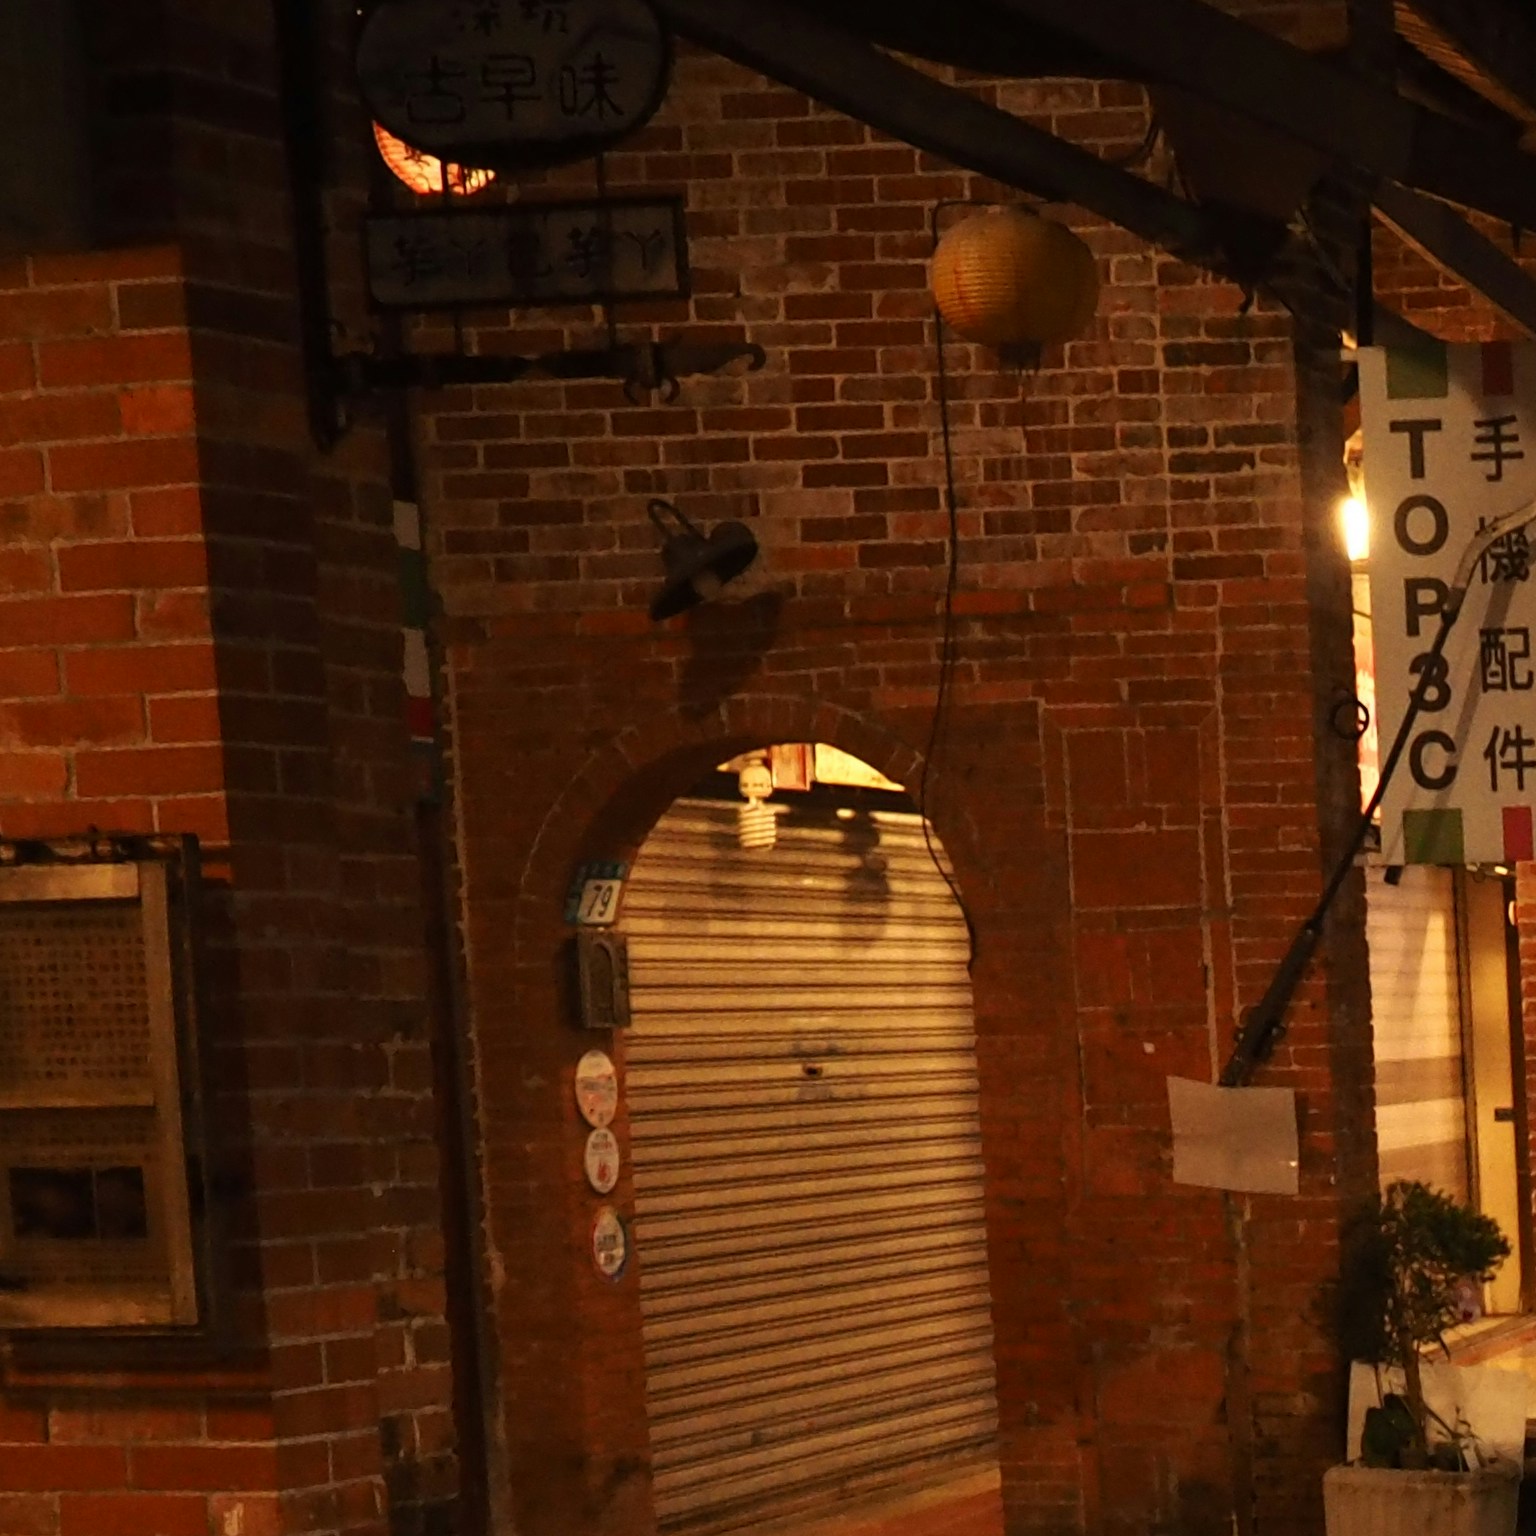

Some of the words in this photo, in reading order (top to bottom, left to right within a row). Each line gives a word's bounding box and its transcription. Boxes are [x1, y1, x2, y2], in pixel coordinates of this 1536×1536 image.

[404, 53, 624, 124] 古早味
[586, 885, 613, 917] 79
